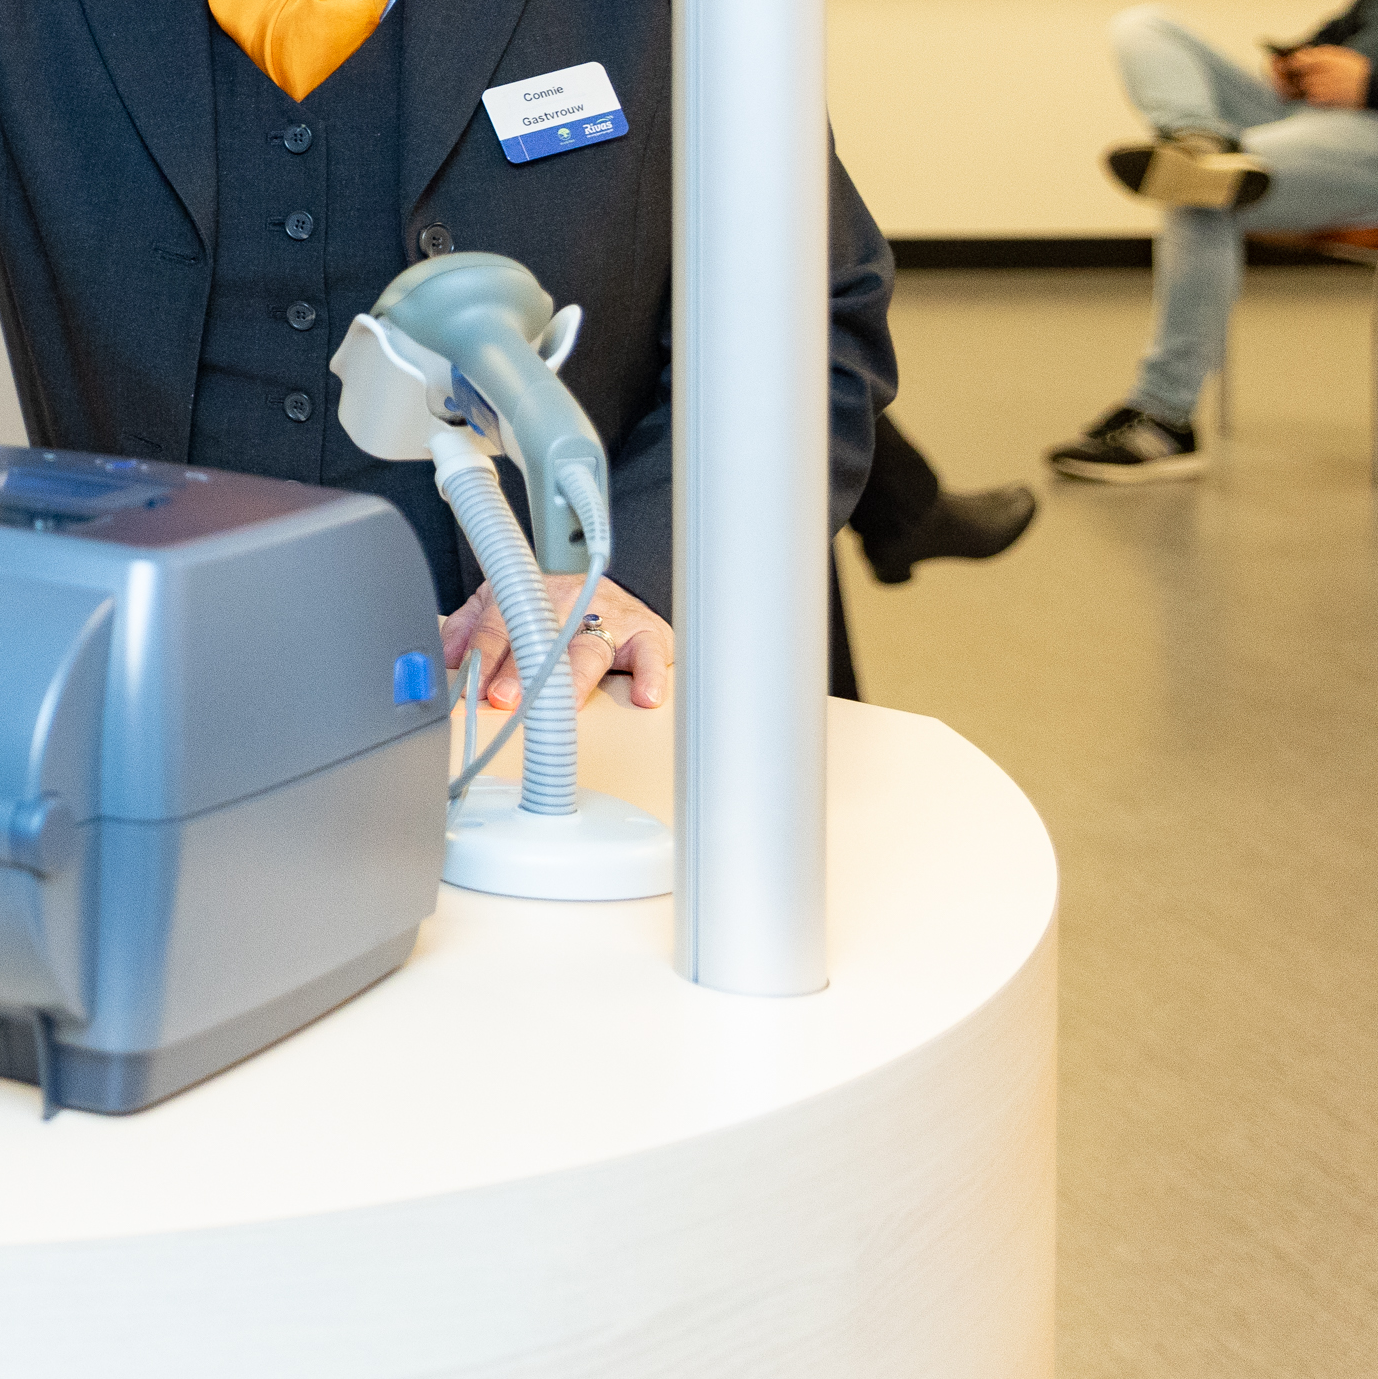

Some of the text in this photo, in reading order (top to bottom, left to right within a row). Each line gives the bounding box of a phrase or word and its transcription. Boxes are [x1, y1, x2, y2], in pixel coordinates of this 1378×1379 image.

[523, 85, 564, 102] Connie
[522, 104, 584, 126] Gastvrouw
[583, 120, 613, 135] Rivas
